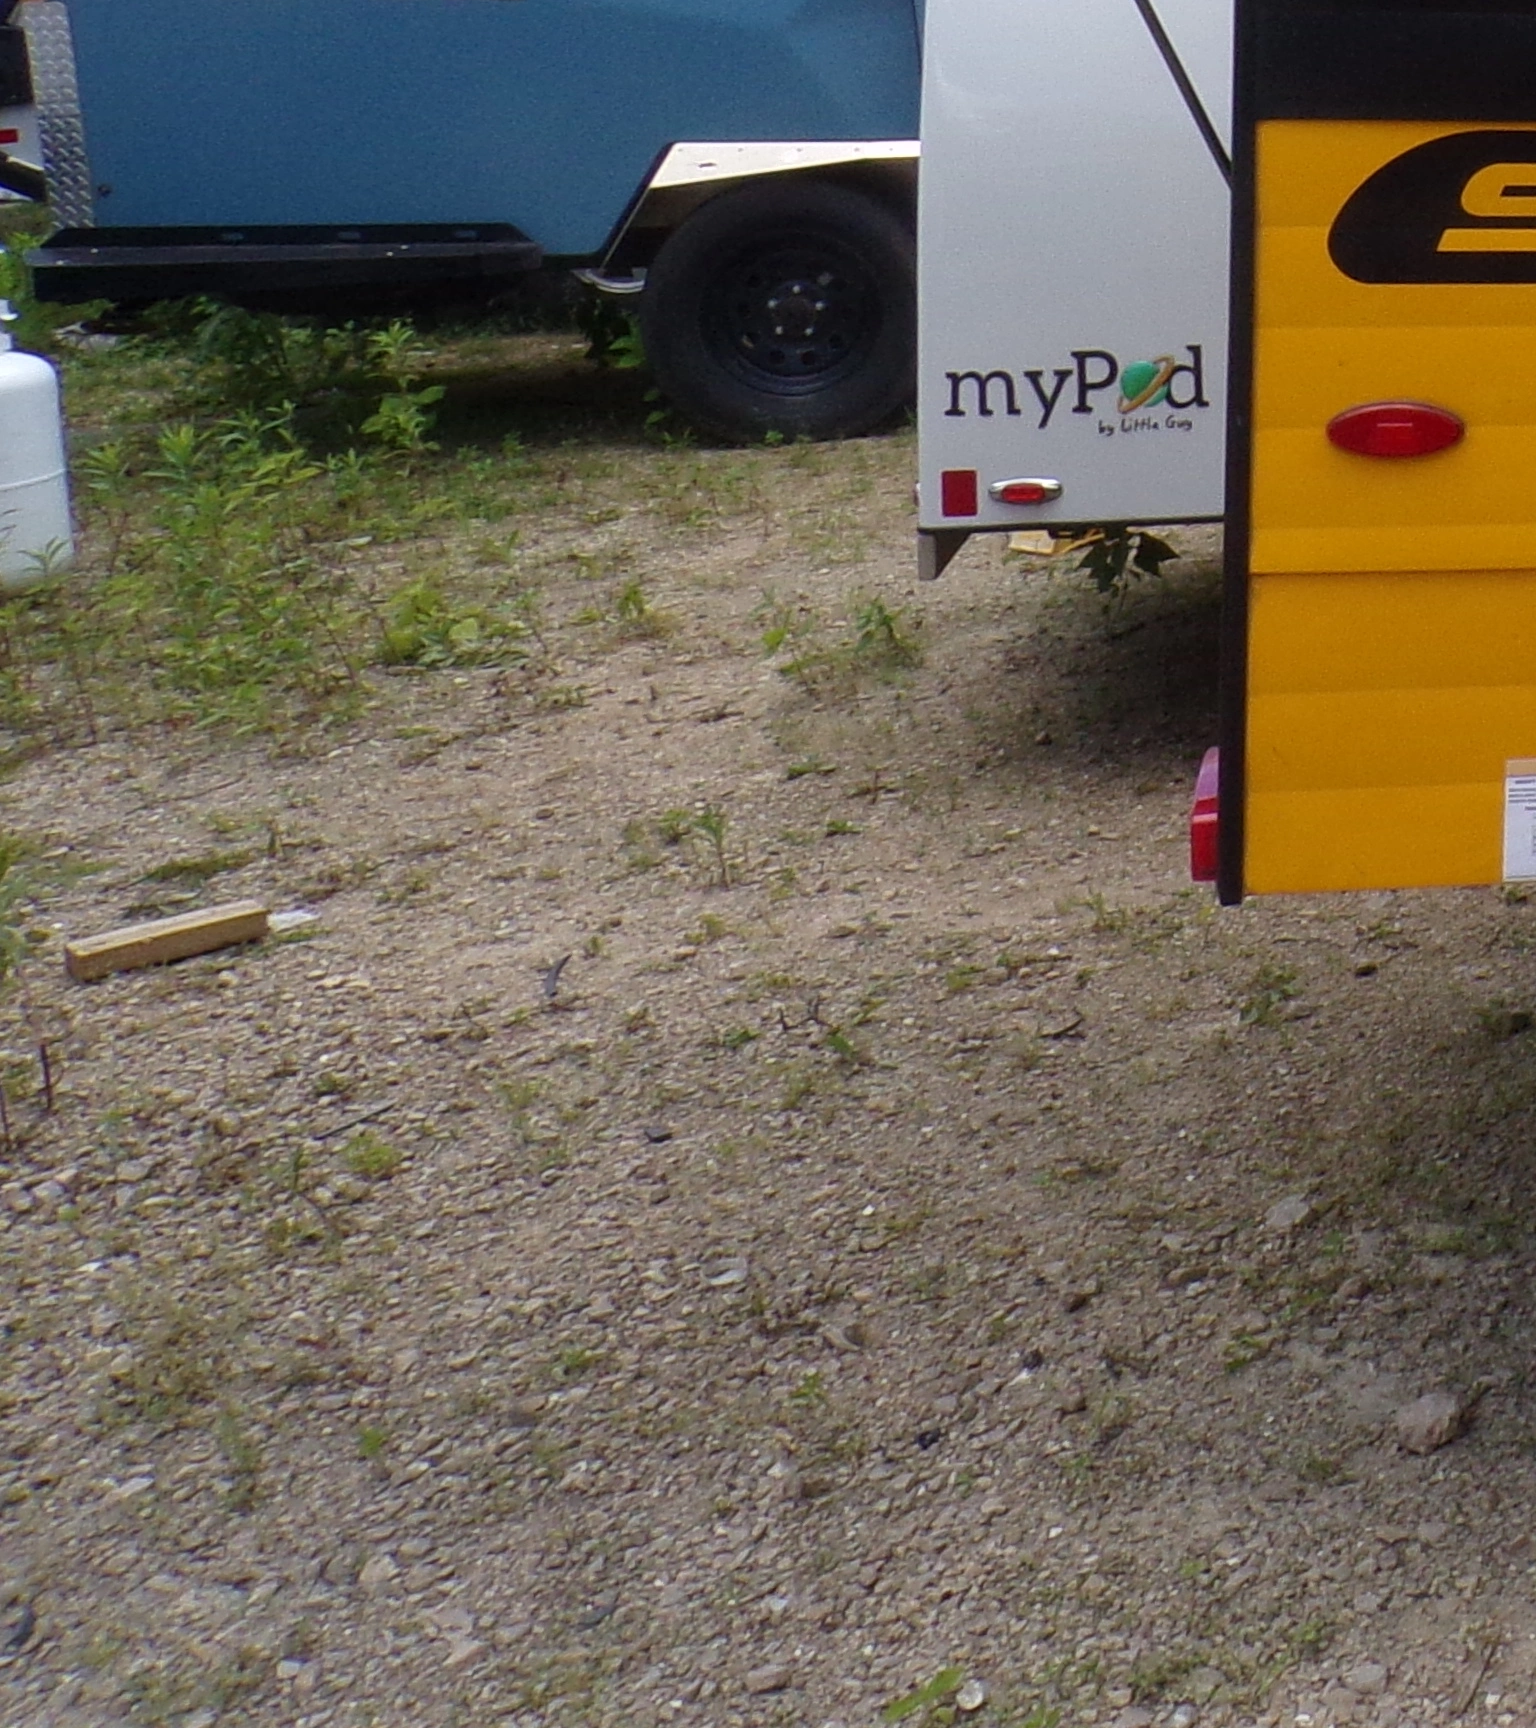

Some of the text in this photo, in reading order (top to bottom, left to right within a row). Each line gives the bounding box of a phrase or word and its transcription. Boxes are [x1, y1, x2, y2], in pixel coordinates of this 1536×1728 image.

[1098, 415, 1193, 436] by Little Guy
